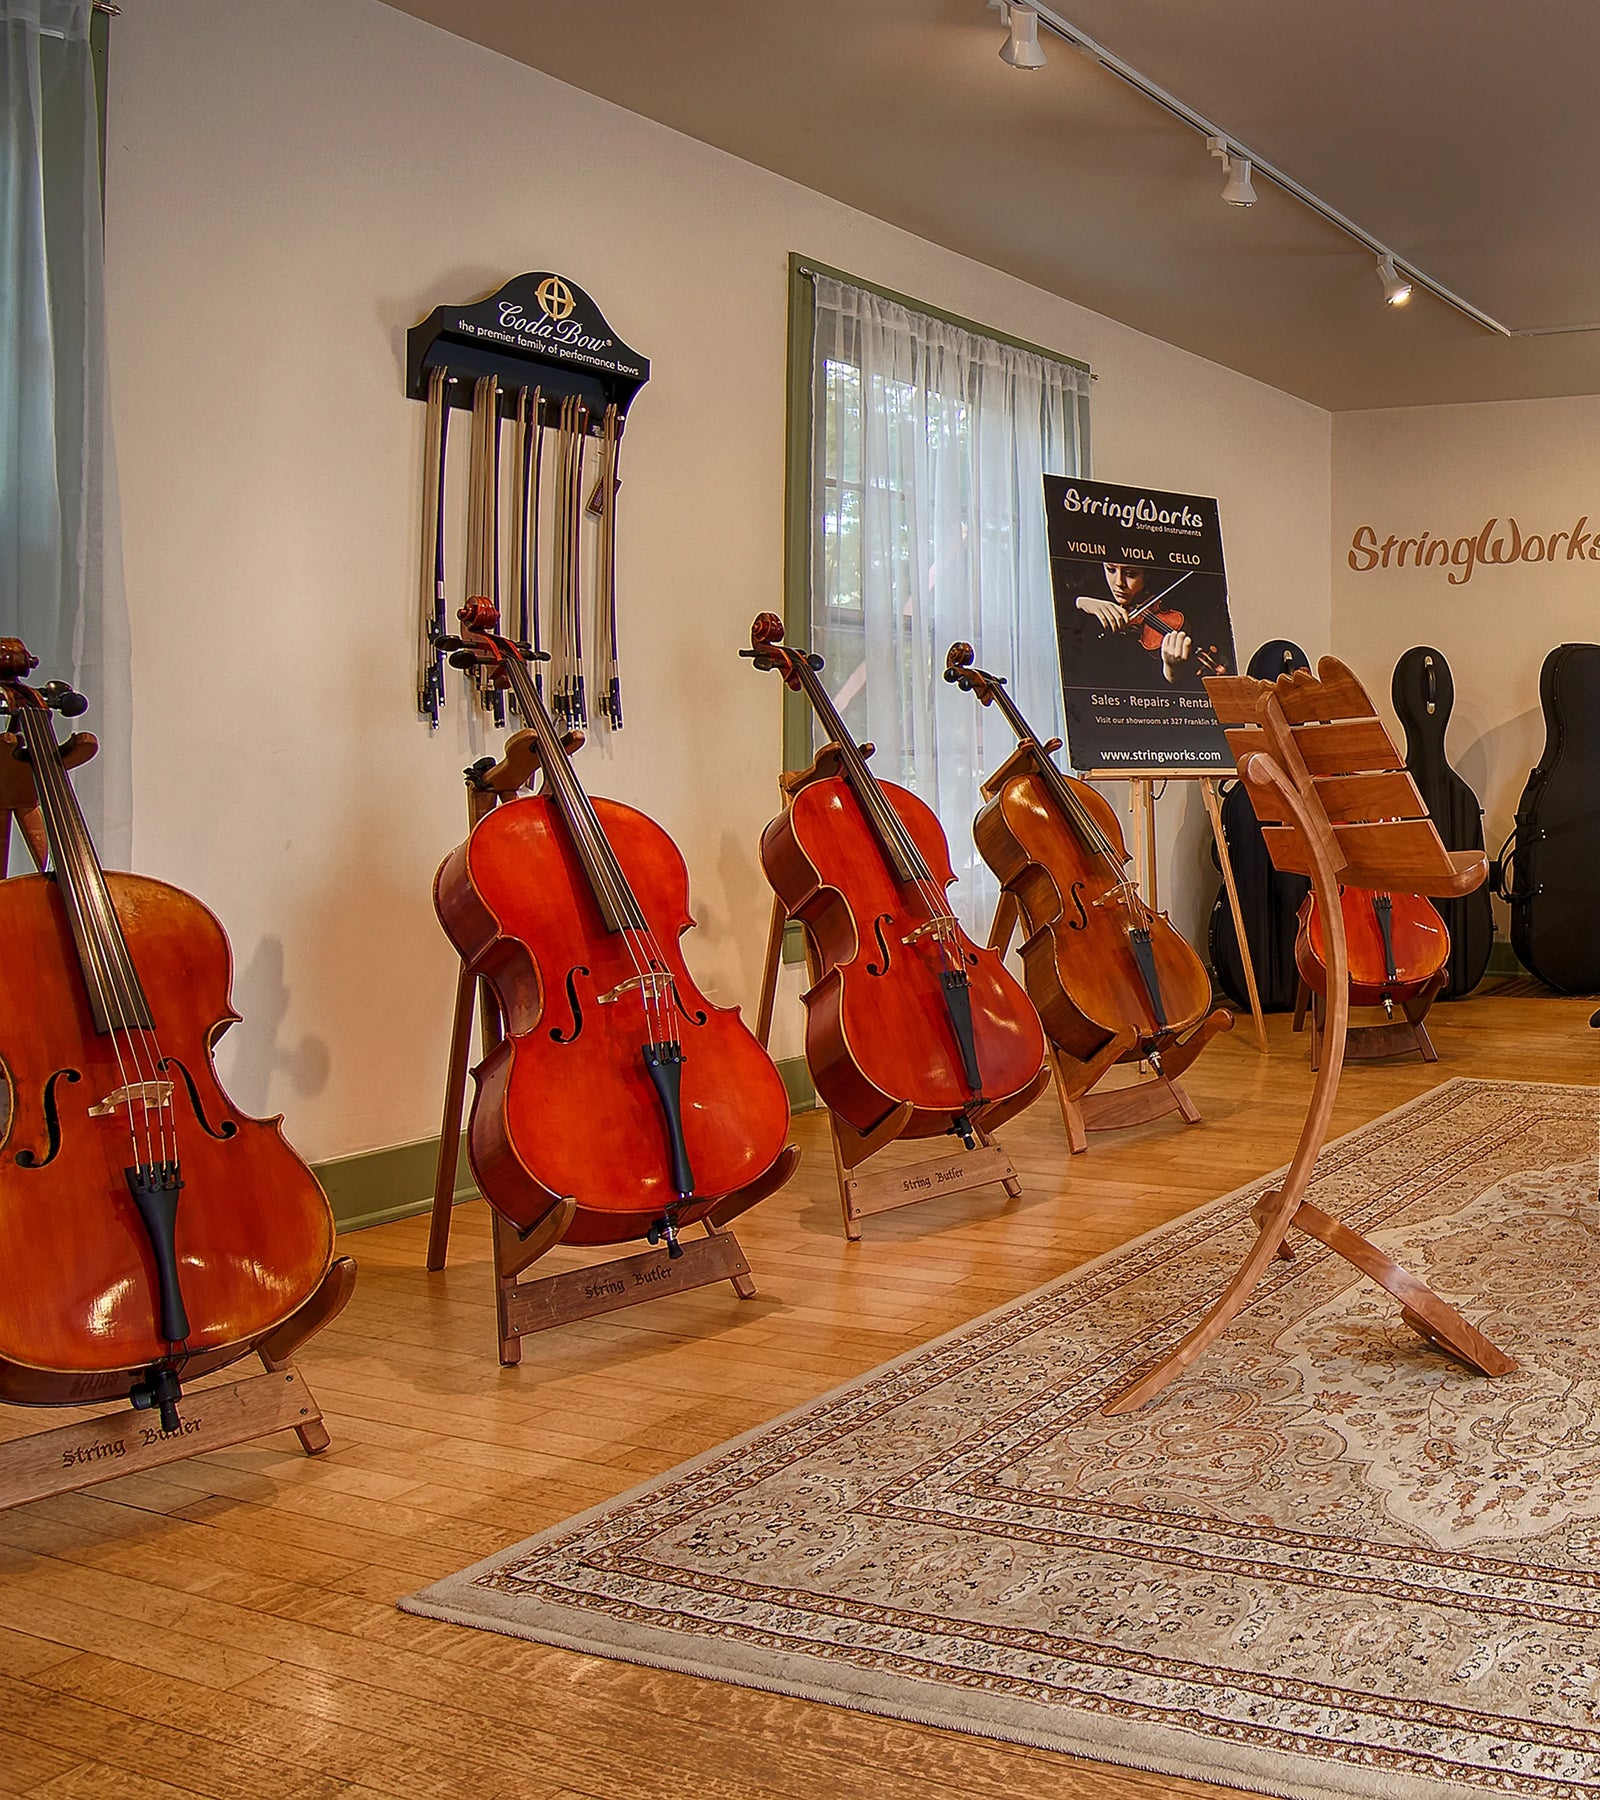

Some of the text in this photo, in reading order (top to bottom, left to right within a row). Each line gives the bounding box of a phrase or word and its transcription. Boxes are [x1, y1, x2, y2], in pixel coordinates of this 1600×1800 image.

[458, 319, 640, 376] the premier family of performance bows
[1063, 487, 1204, 528] StringWorks
[1135, 522, 1202, 537] Stringed Instruments
[1067, 540, 1201, 566] VIOLIN VIOLA CELLO
[1090, 693, 1121, 706] Sales
[1129, 695, 1170, 709] Repairs
[1095, 716, 1112, 724] Visit
[1125, 716, 1162, 725] showroom
[1162, 717, 1170, 725] at
[1170, 717, 1183, 725] 327
[1183, 717, 1210, 726] Franklin
[1100, 748, 1222, 763] www.stringworks.com
[902, 1166, 964, 1192] String Butler
[583, 1264, 673, 1300] String Butler
[62, 1436, 127, 1468] String
